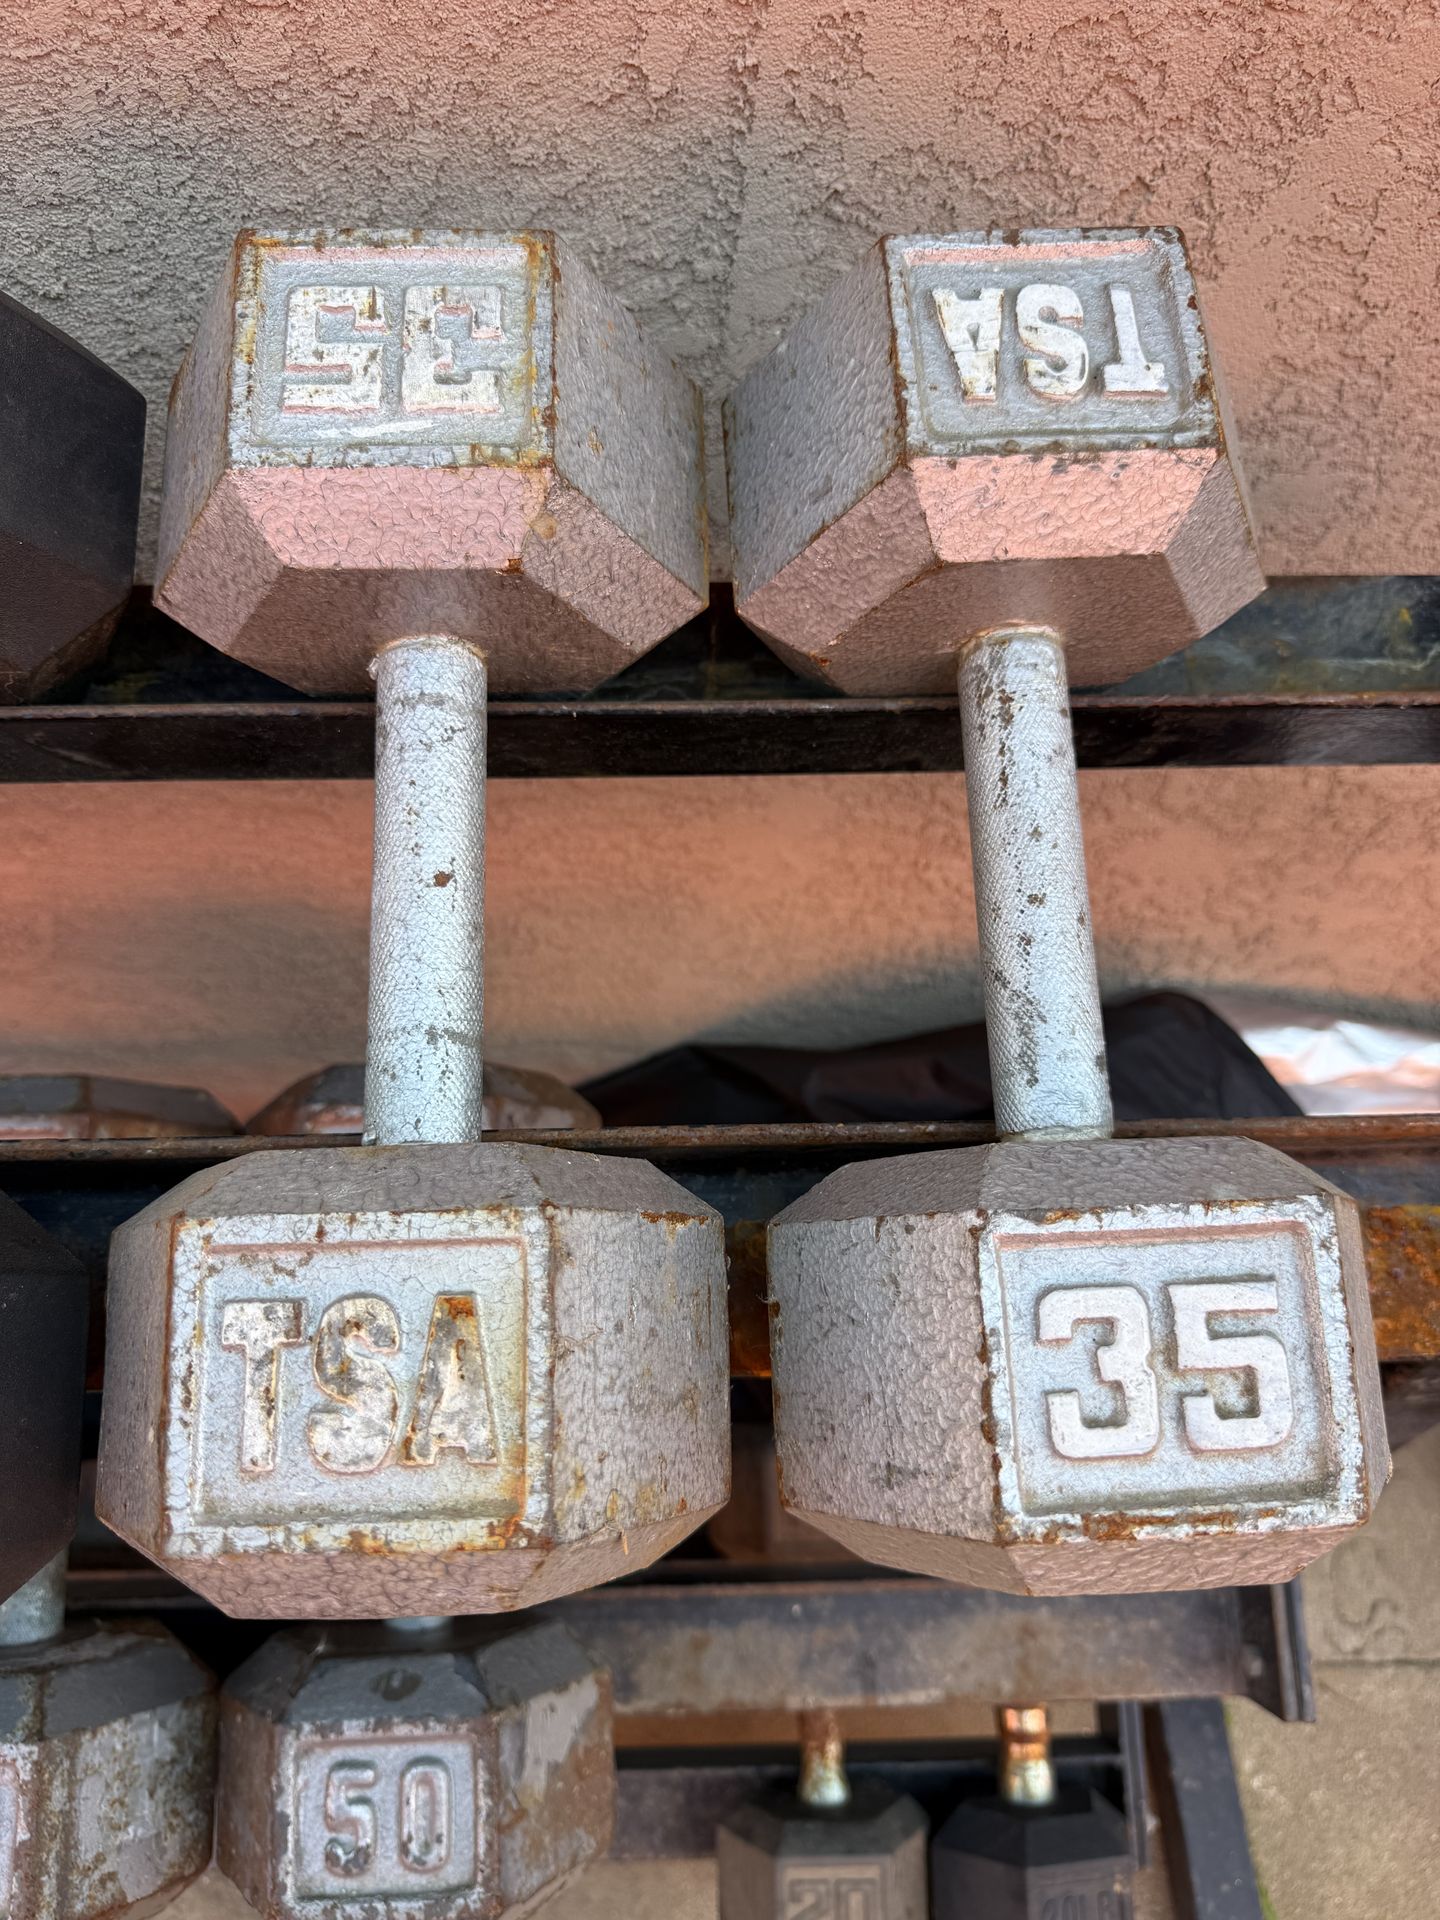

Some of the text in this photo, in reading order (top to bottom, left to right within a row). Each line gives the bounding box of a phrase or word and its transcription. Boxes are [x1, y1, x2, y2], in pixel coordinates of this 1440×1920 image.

[282, 285, 501, 413] 35
[931, 283, 1169, 404] TSA
[221, 1294, 498, 1474] TSA
[1037, 1280, 1296, 1461] 35
[324, 1757, 452, 1878] 50
